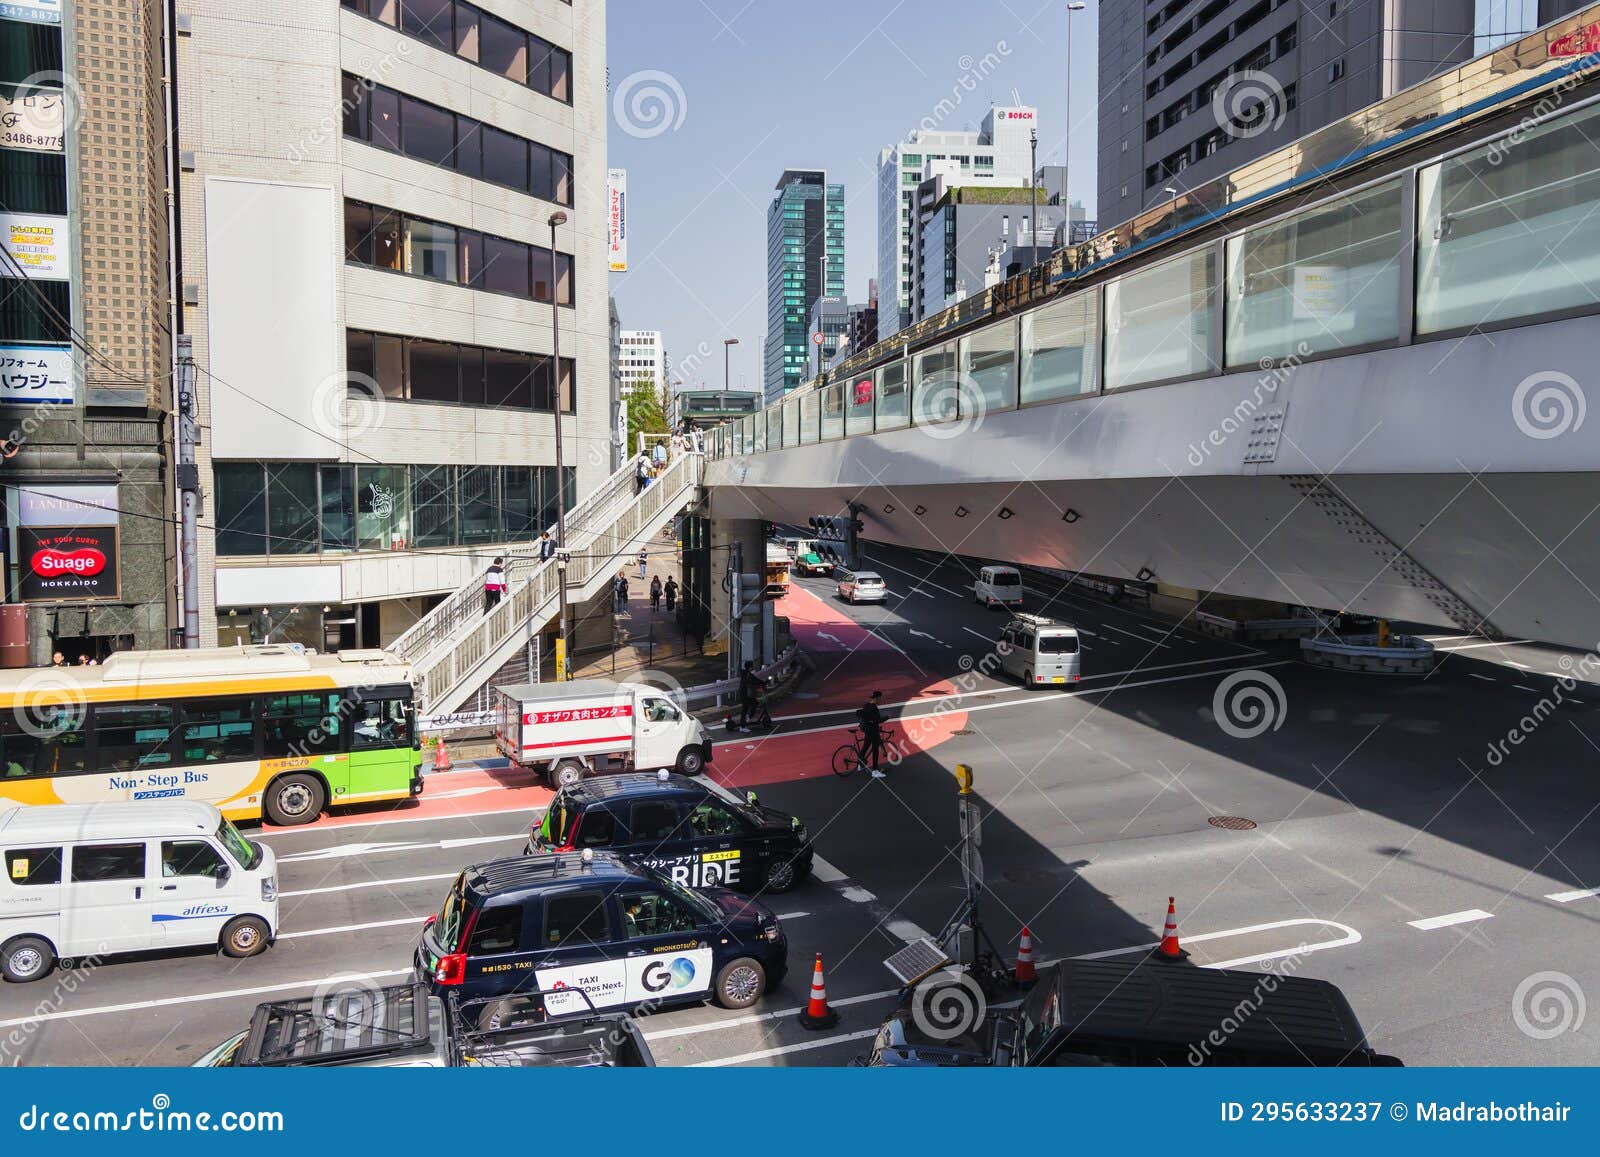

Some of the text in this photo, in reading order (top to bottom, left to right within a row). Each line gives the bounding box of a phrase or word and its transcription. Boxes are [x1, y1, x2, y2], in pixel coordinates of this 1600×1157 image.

[37, 535, 99, 546] THE SOUP CURRY
[42, 556, 95, 570] Suage
[542, 706, 628, 723] オザワ食肉センター
[184, 771, 209, 783] Bus
[672, 859, 740, 887] RIDE
[182, 904, 229, 916] alfresa
[514, 961, 532, 969] TAXI
[578, 975, 599, 985] TAXI
[602, 980, 624, 991] Next.
